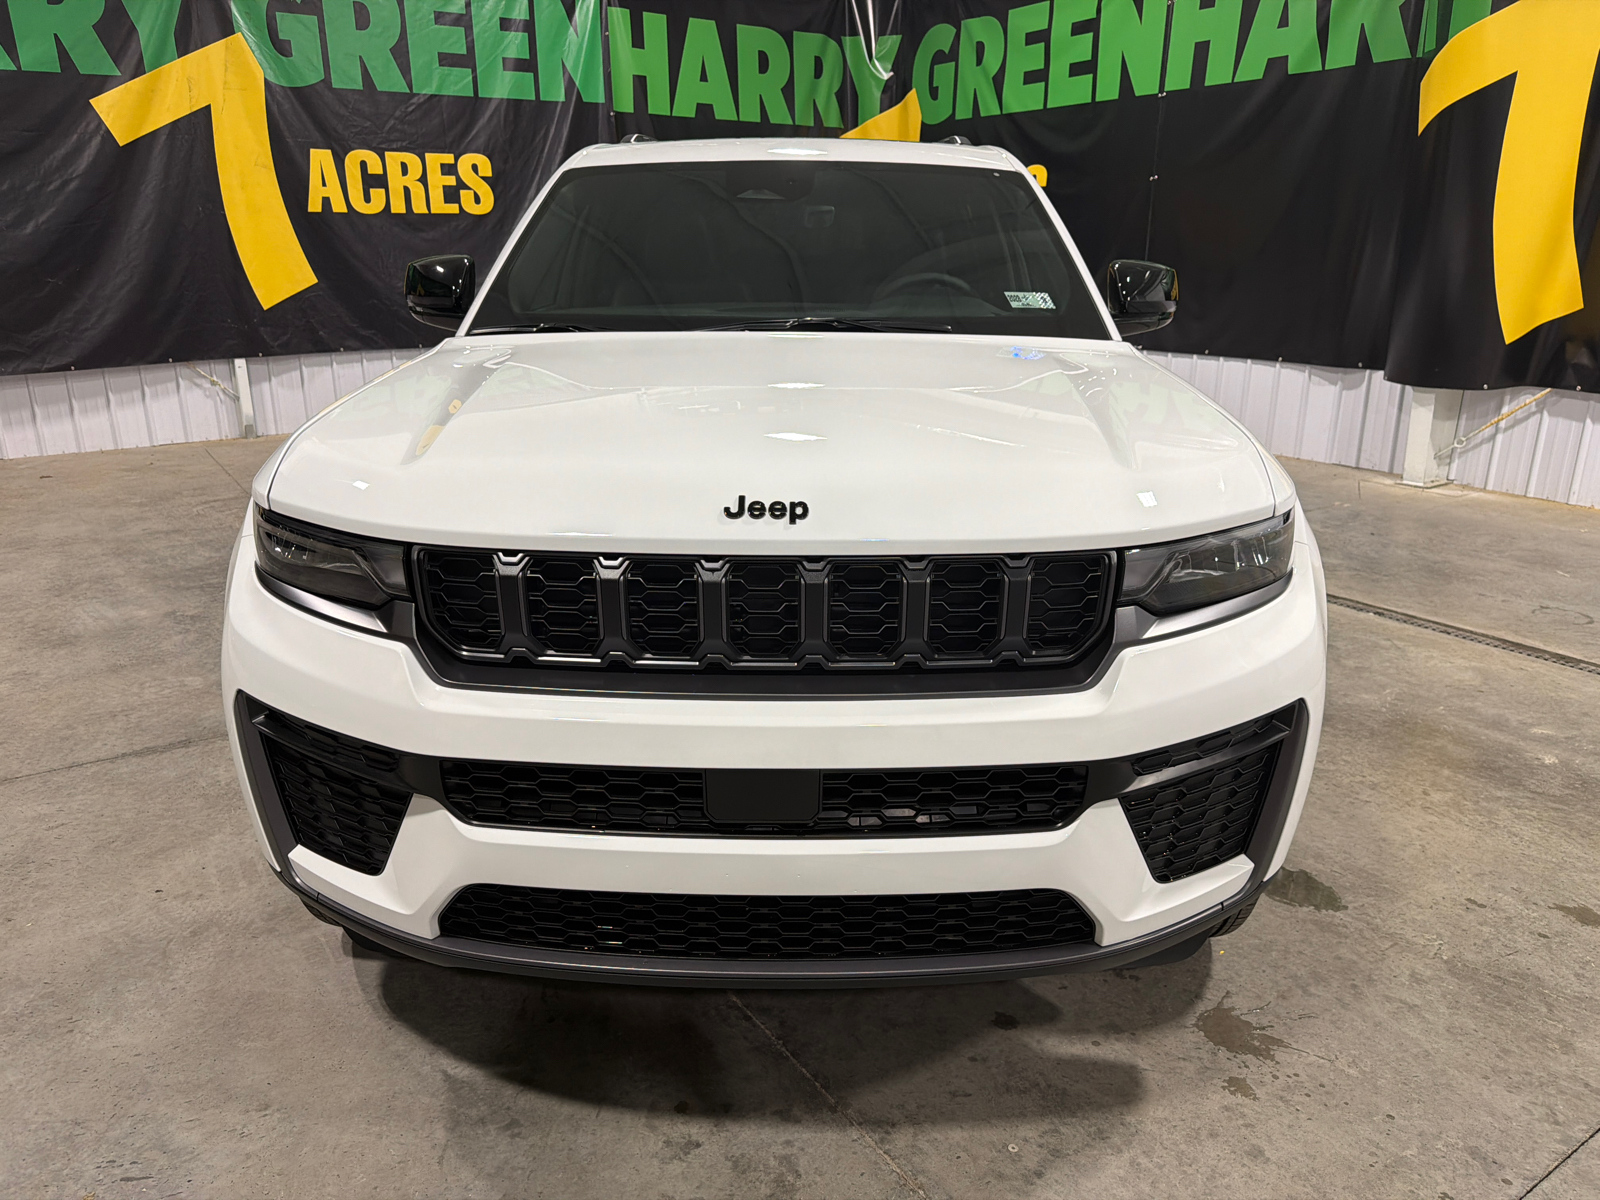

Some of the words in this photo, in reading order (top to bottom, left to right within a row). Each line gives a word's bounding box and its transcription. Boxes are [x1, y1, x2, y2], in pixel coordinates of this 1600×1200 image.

[0, 0, 182, 76] RY
[230, 0, 606, 104] GREEN
[607, 6, 903, 130] HARRY
[912, 0, 1168, 126] GREEN
[90, 32, 319, 311] 7
[308, 148, 495, 216] ACRES
[1419, 0, 1600, 346] 7
[723, 494, 810, 525] Jeep
